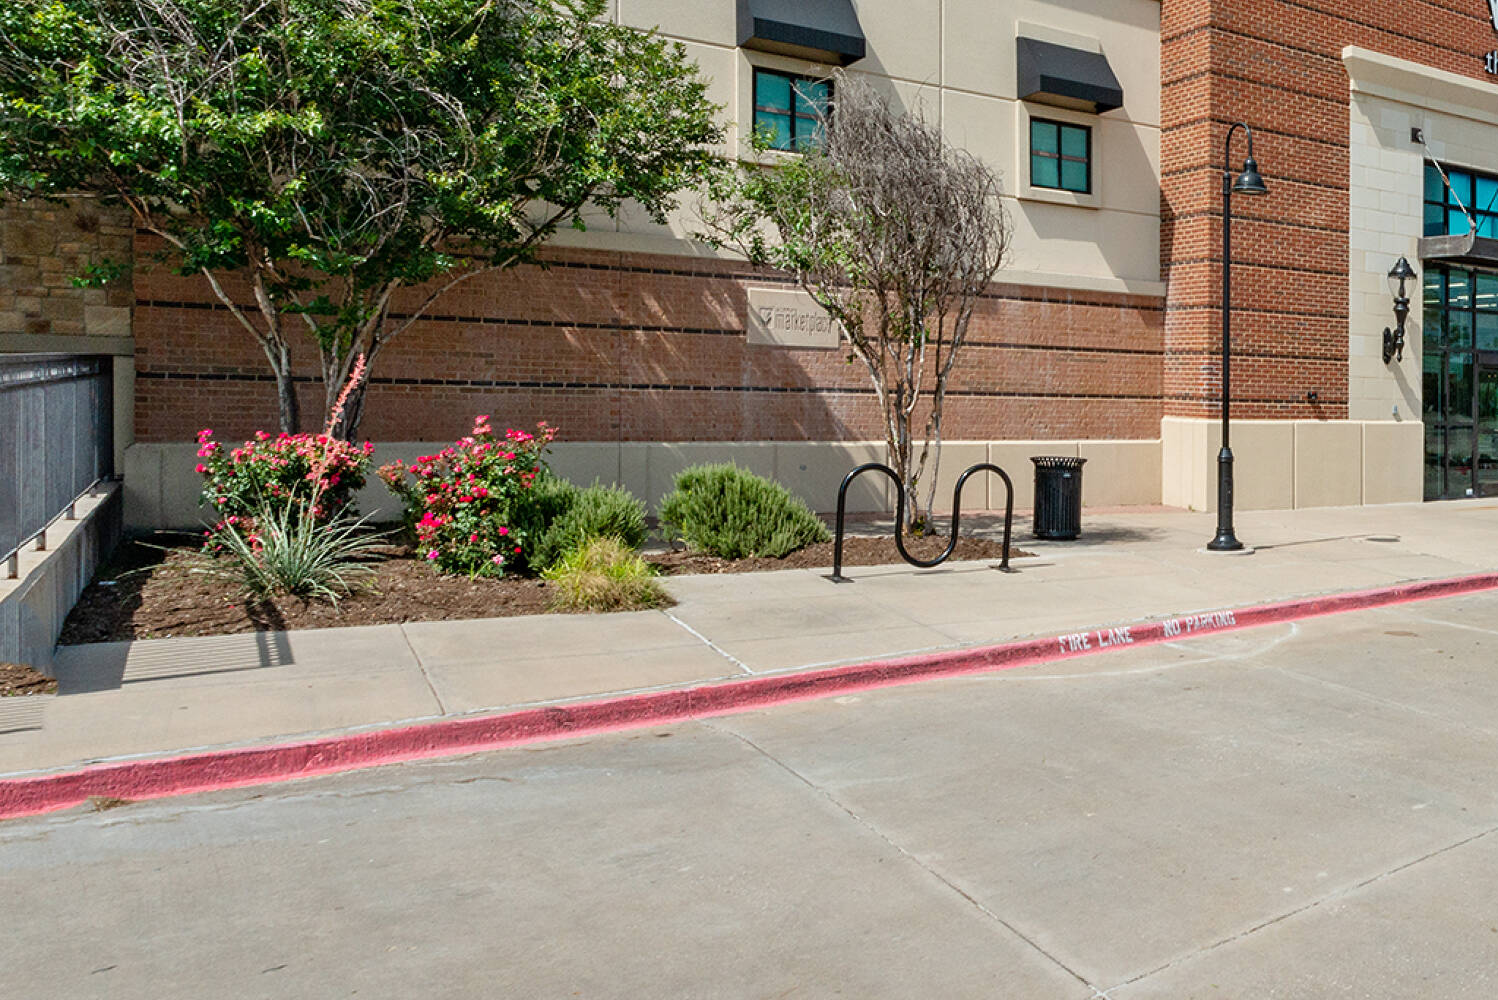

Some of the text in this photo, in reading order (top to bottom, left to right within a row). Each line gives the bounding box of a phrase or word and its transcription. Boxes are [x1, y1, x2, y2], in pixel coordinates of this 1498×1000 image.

[1058, 611, 1236, 654] FIRE LANE NO PARKING
